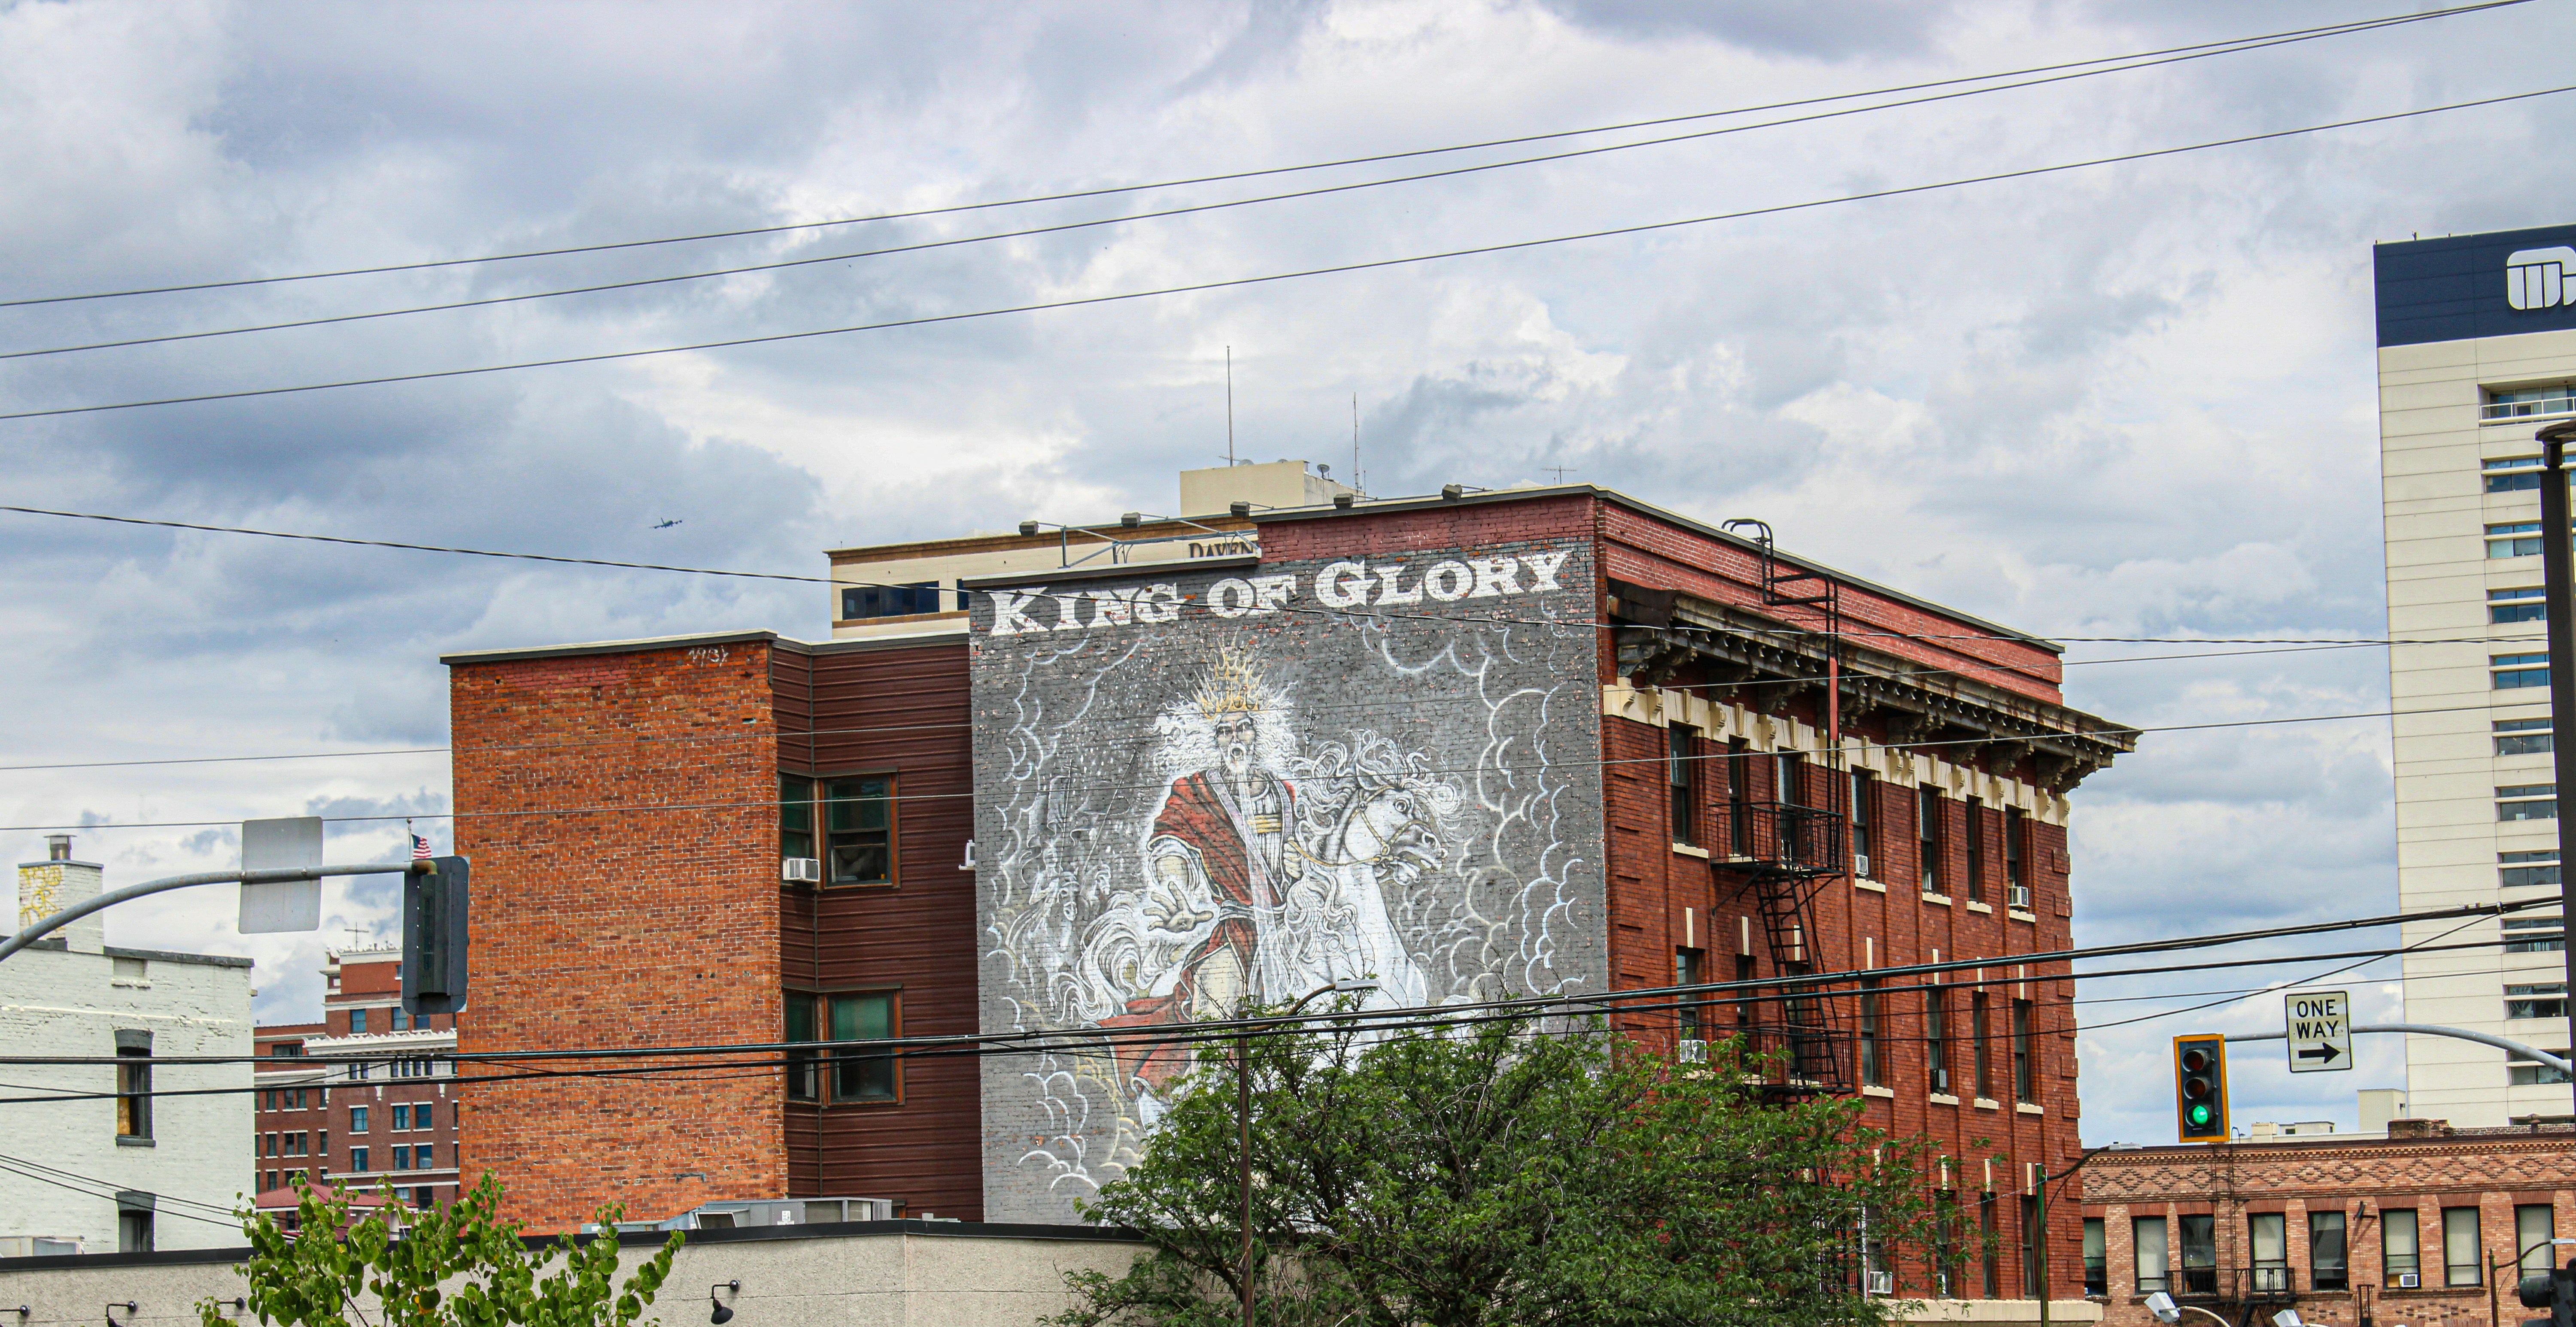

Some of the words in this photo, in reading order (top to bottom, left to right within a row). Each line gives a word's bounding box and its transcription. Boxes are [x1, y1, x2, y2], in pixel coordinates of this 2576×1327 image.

[988, 581, 1186, 636] KING
[1206, 574, 1297, 619] OF
[1314, 550, 1572, 608] GLORY
[2297, 999, 2337, 1018] ONE
[2296, 1020, 2339, 1039] WAY
